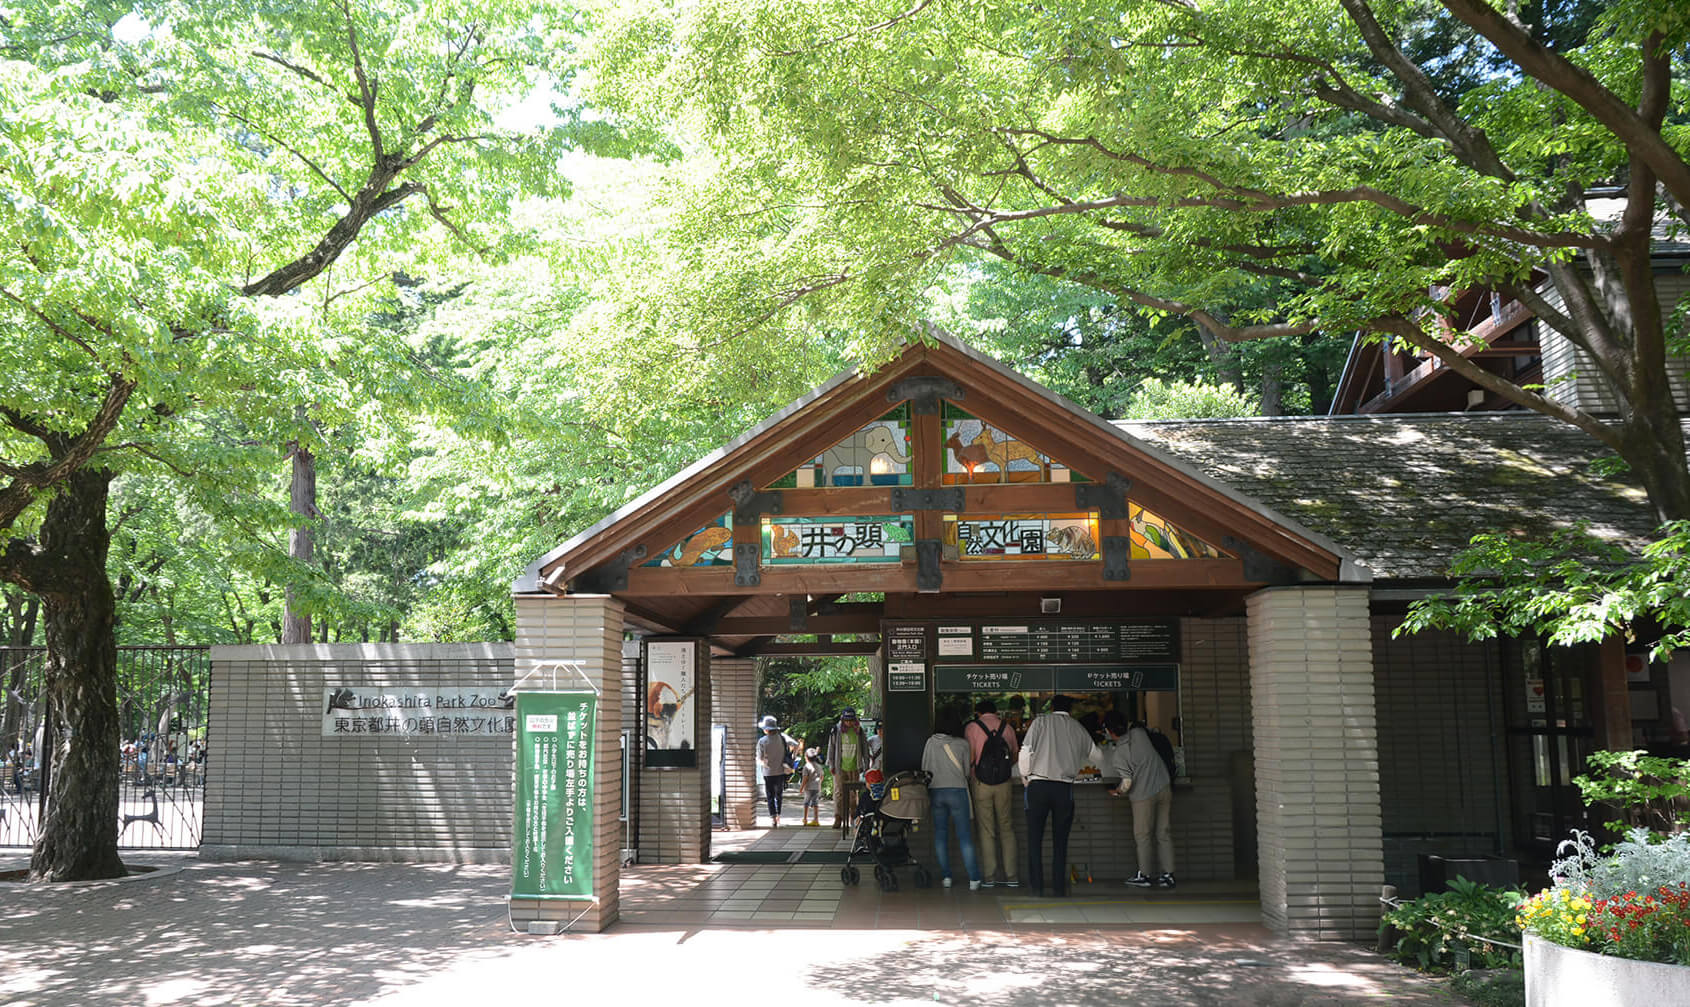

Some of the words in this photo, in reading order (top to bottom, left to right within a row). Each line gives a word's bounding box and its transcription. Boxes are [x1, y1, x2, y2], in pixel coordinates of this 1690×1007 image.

[801, 522, 883, 557] 井の頭
[958, 520, 1043, 554] 自然文化園
[358, 694, 431, 708] Inokashira
[436, 695, 465, 708] Park
[470, 694, 496, 707] Zoo
[577, 702, 589, 812] チケットをお持ちの方は、
[563, 711, 577, 884] 並ばずに売り場左手よりご入園ください
